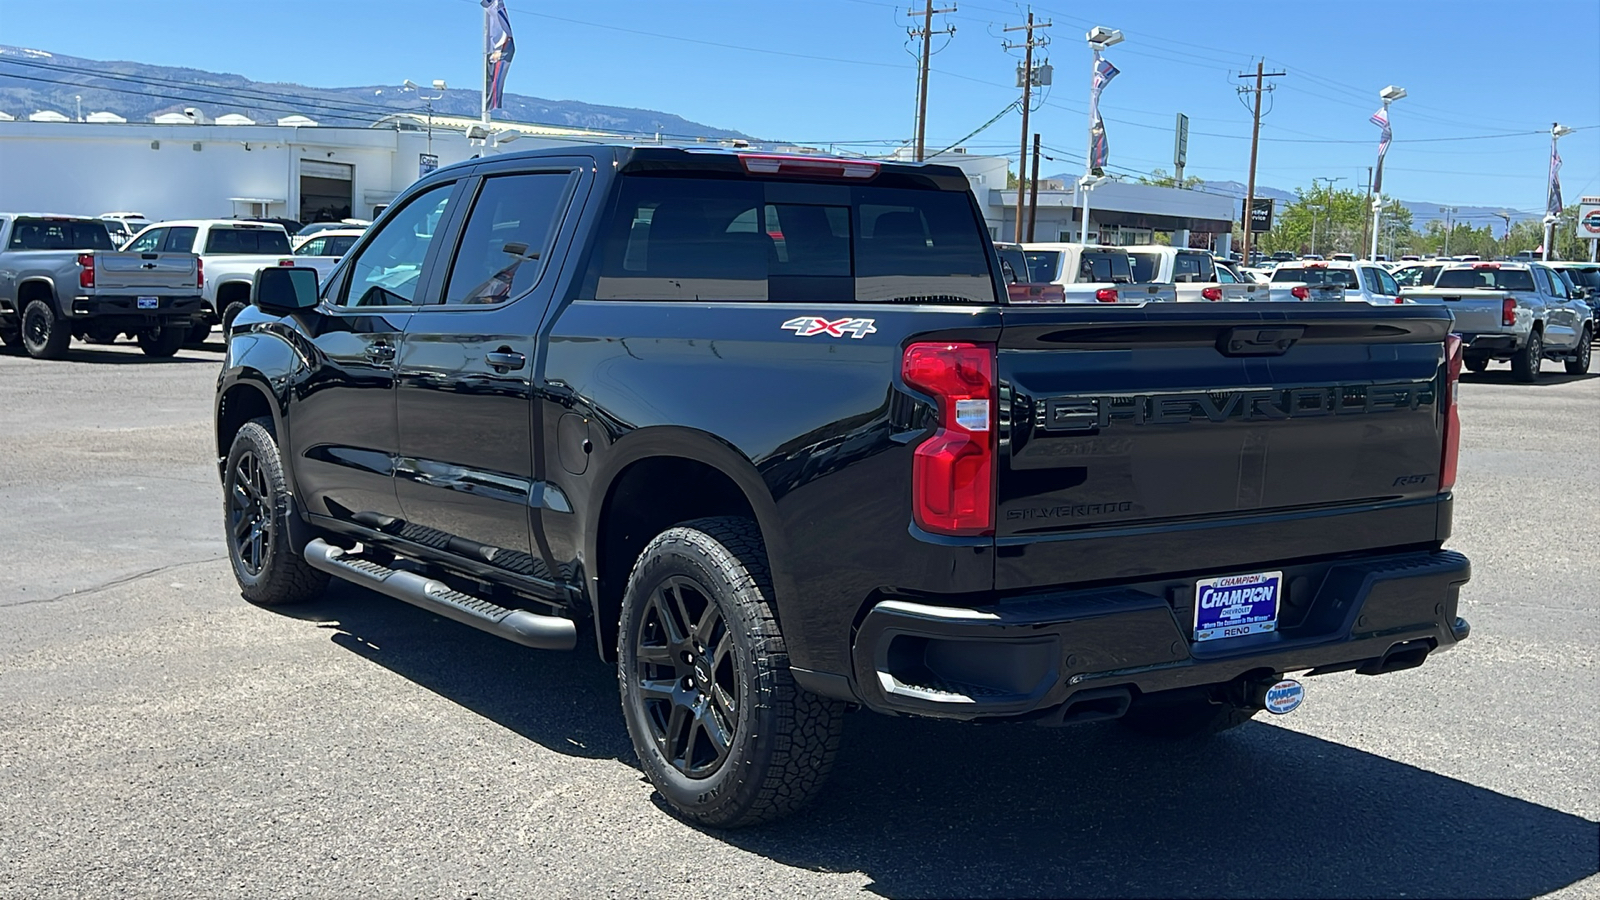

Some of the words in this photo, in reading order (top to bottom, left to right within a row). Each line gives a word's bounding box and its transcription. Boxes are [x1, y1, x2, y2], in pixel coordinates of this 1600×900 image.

[1043, 383, 1433, 432] CHEVROLET
[1392, 473, 1435, 487] RST
[1006, 501, 1133, 520] SILVERADO
[1220, 574, 1260, 587] CHAMPION
[1201, 586, 1275, 609] CHAMPION
[1222, 606, 1251, 616] CHEVROLET
[1224, 626, 1250, 637] RENO
